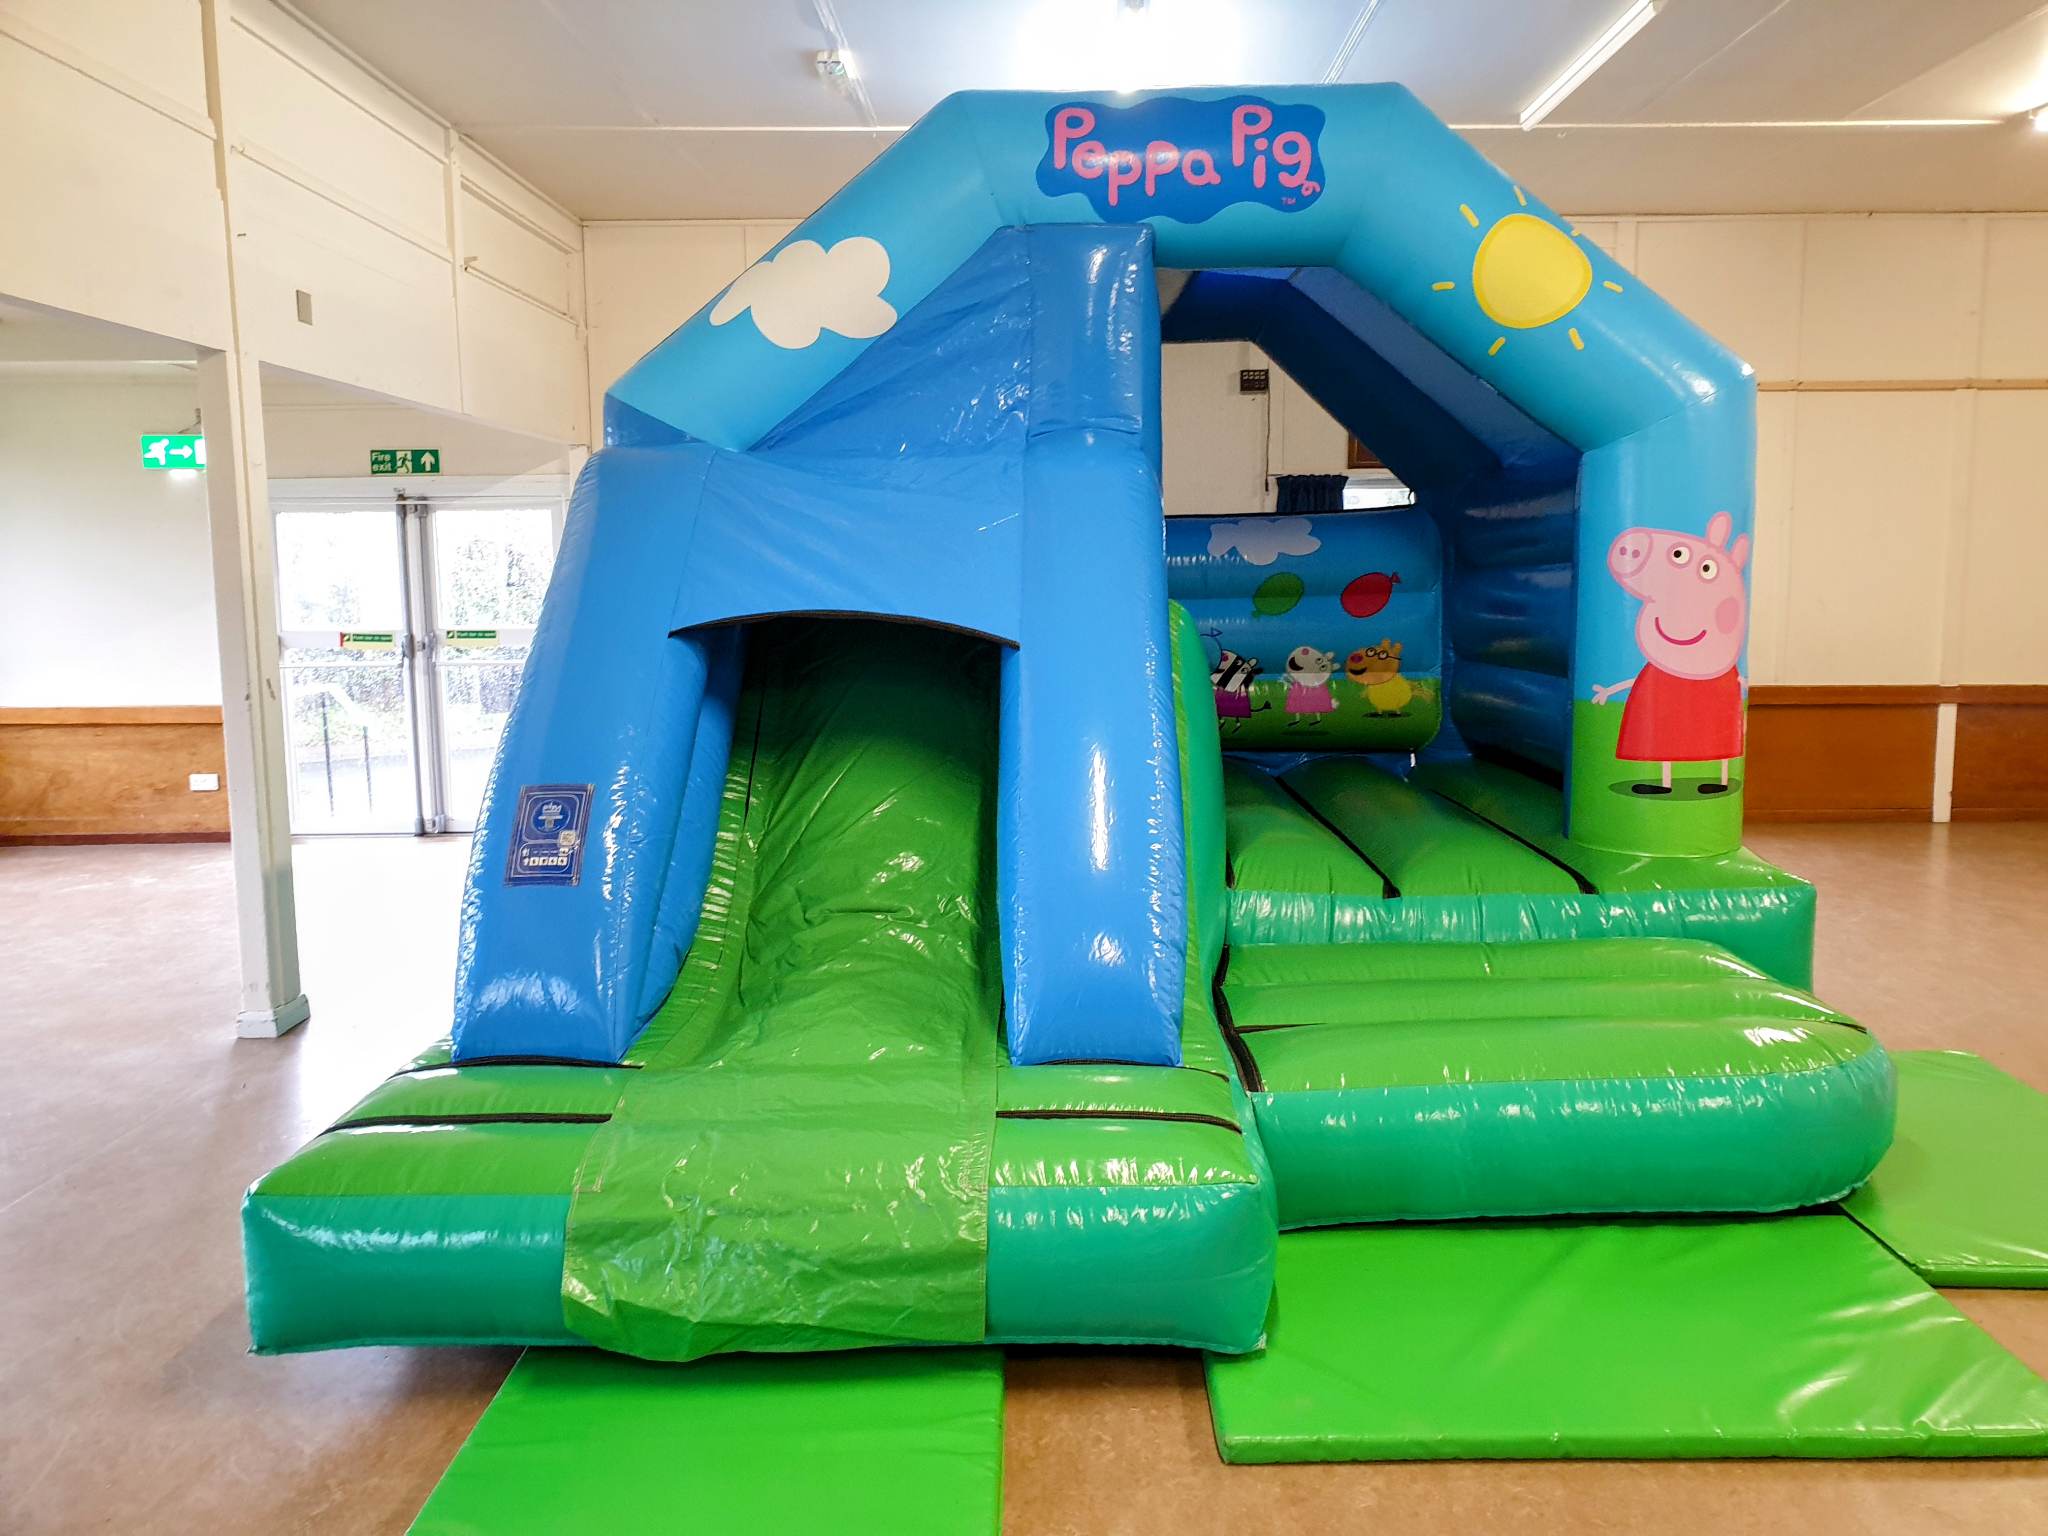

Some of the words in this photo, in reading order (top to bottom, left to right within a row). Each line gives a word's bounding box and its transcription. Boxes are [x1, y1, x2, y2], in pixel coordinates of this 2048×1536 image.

[1054, 107, 1221, 206] Peppa
[1232, 104, 1320, 196] Pig
[372, 452, 391, 462] Fire
[372, 463, 392, 472] exit
